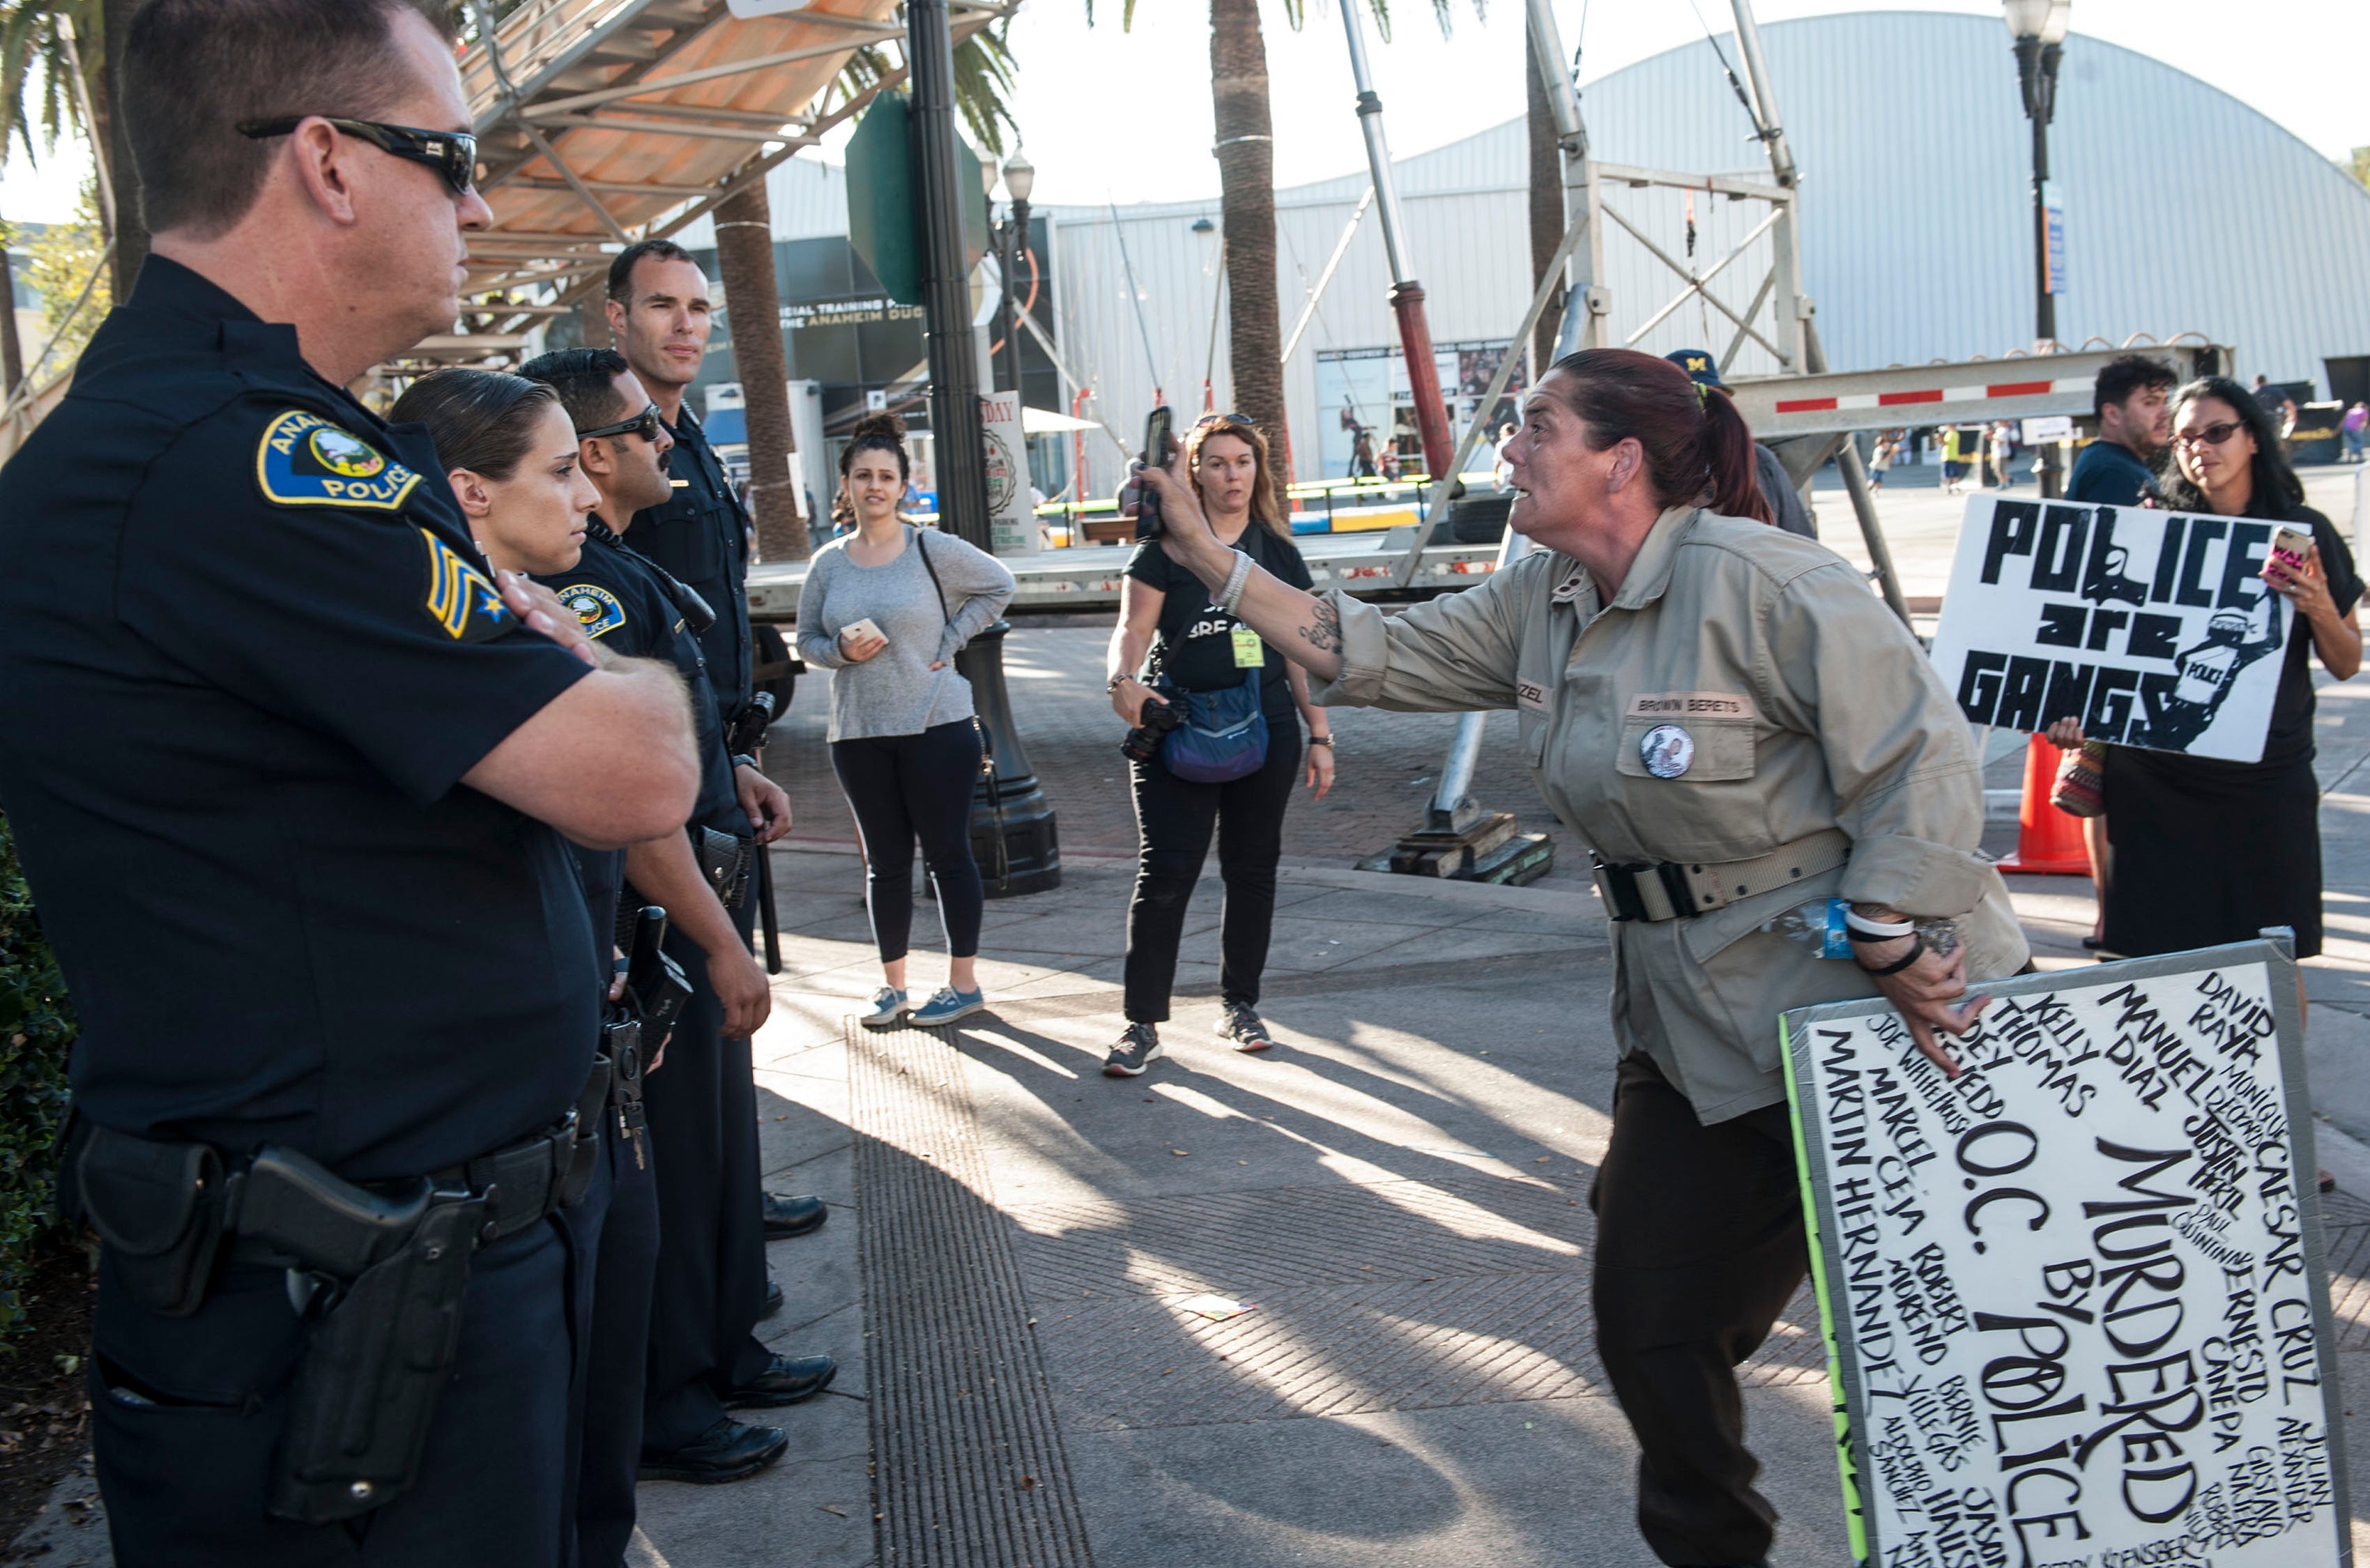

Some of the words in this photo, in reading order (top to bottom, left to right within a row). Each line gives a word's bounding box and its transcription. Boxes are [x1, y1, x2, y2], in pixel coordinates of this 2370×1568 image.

[807, 310, 882, 327] ANAHEIM
[888, 305, 924, 320] DUC
[816, 299, 883, 314] TRAINING
[1685, 357, 1707, 371] M
[320, 463, 413, 500] POLICE
[558, 587, 614, 605] NAHEIM
[1980, 500, 2273, 610] POLICE
[1638, 699, 1683, 712] BROWN
[1866, 1013, 1911, 1051] JOE
[1991, 996, 2097, 1119] THOMAS
[2026, 993, 2101, 1066] KELLY
[2097, 983, 2215, 1107] MANUEL
[2104, 1032, 2169, 1113] DIAZ
[2187, 1003, 2262, 1067] RAYA
[1817, 1028, 1874, 1168] MARTIN
[1866, 1066, 1938, 1176] MARCEL
[1956, 1119, 2051, 1254] O.C.
[2190, 1203, 2231, 1243] PAUL
[2254, 1140, 2307, 1293] CAESAR
[1833, 1176, 1908, 1419] HERNANDEZ
[1884, 1257, 1948, 1366] MORENO
[1911, 1242, 1973, 1337] ROBERT
[2037, 1258, 2095, 1325] BY
[2072, 1136, 2205, 1524] MURDERED
[2221, 1264, 2270, 1404] ERNESTO
[2200, 1336, 2244, 1454] CANEPA
[2270, 1298, 2321, 1406] CRUZ
[1936, 1374, 1987, 1452] BERNIE
[1869, 1440, 1924, 1525] SANCHEZ
[2245, 1445, 2285, 1539] GUSTAVO
